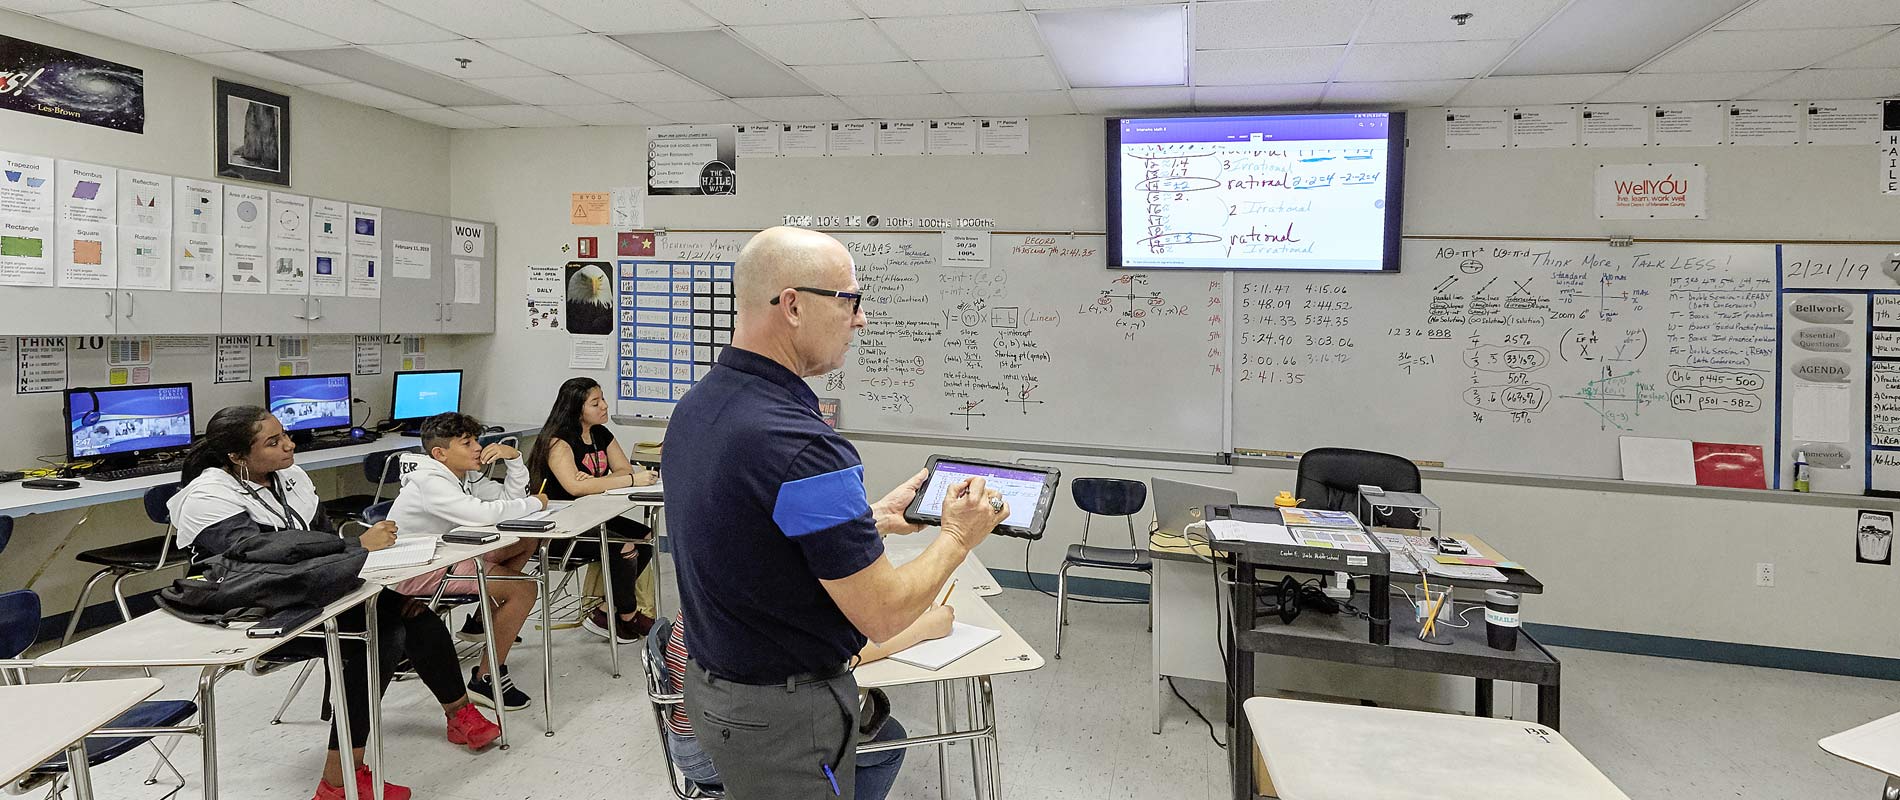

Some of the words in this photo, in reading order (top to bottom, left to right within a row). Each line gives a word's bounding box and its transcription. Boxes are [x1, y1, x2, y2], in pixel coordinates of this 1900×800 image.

[0, 67, 45, 97] s!
[38, 103, 52, 112] Les
[54, 106, 80, 117] Brown
[7, 160, 40, 170] Trapezoid
[1223, 160, 1231, 170] 3
[73, 169, 103, 179] Rhombus
[132, 178, 160, 187] Reflection
[702, 176, 732, 186] HAILE
[1227, 173, 1292, 190] rational
[186, 185, 212, 194] Translation
[1230, 204, 1237, 216] 2
[5, 223, 39, 232] Rectangle
[783, 216, 812, 227] 100's
[817, 216, 840, 226] 10's
[845, 216, 861, 227] 1's
[886, 217, 913, 227] 10ths
[919, 219, 951, 228] 100ths
[957, 218, 995, 227] 1000ths
[134, 233, 158, 241] Rotation
[455, 226, 481, 238] WOW
[1230, 222, 1300, 245] rational
[1025, 236, 1056, 245] RECORD
[847, 242, 892, 253] PEMDAS
[1060, 248, 1096, 257] 2:41.35
[678, 250, 722, 261] 2/21/19
[1532, 250, 1571, 267] Think
[1787, 258, 1869, 281] 2/21/19
[1243, 283, 1290, 294] 5:11.47
[1305, 284, 1347, 294] 4:15.06
[1242, 299, 1291, 309] 5:48.09
[1303, 301, 1353, 311] 2:44.52
[1795, 304, 1845, 313] Bellwork
[1304, 315, 1349, 327] 5:34.35
[1550, 311, 1576, 320] Zoom
[999, 328, 1032, 339] y-intercept
[1800, 331, 1836, 339] Essential
[21, 339, 64, 347] THINK
[76, 336, 104, 350] 10
[219, 336, 249, 344] THINK
[1023, 340, 1038, 348] table
[1241, 332, 1293, 346] 5:24.90
[1305, 335, 1354, 348] 3:03.06
[1504, 334, 1531, 345] 25%
[995, 350, 1017, 361] Starting
[1242, 353, 1297, 366] 3:00.66
[1799, 366, 1845, 375] AGENDA
[962, 373, 981, 382] change
[1240, 369, 1305, 384] 2:41.35
[1508, 373, 1529, 384] 50%
[1862, 514, 1890, 522] Garbage
